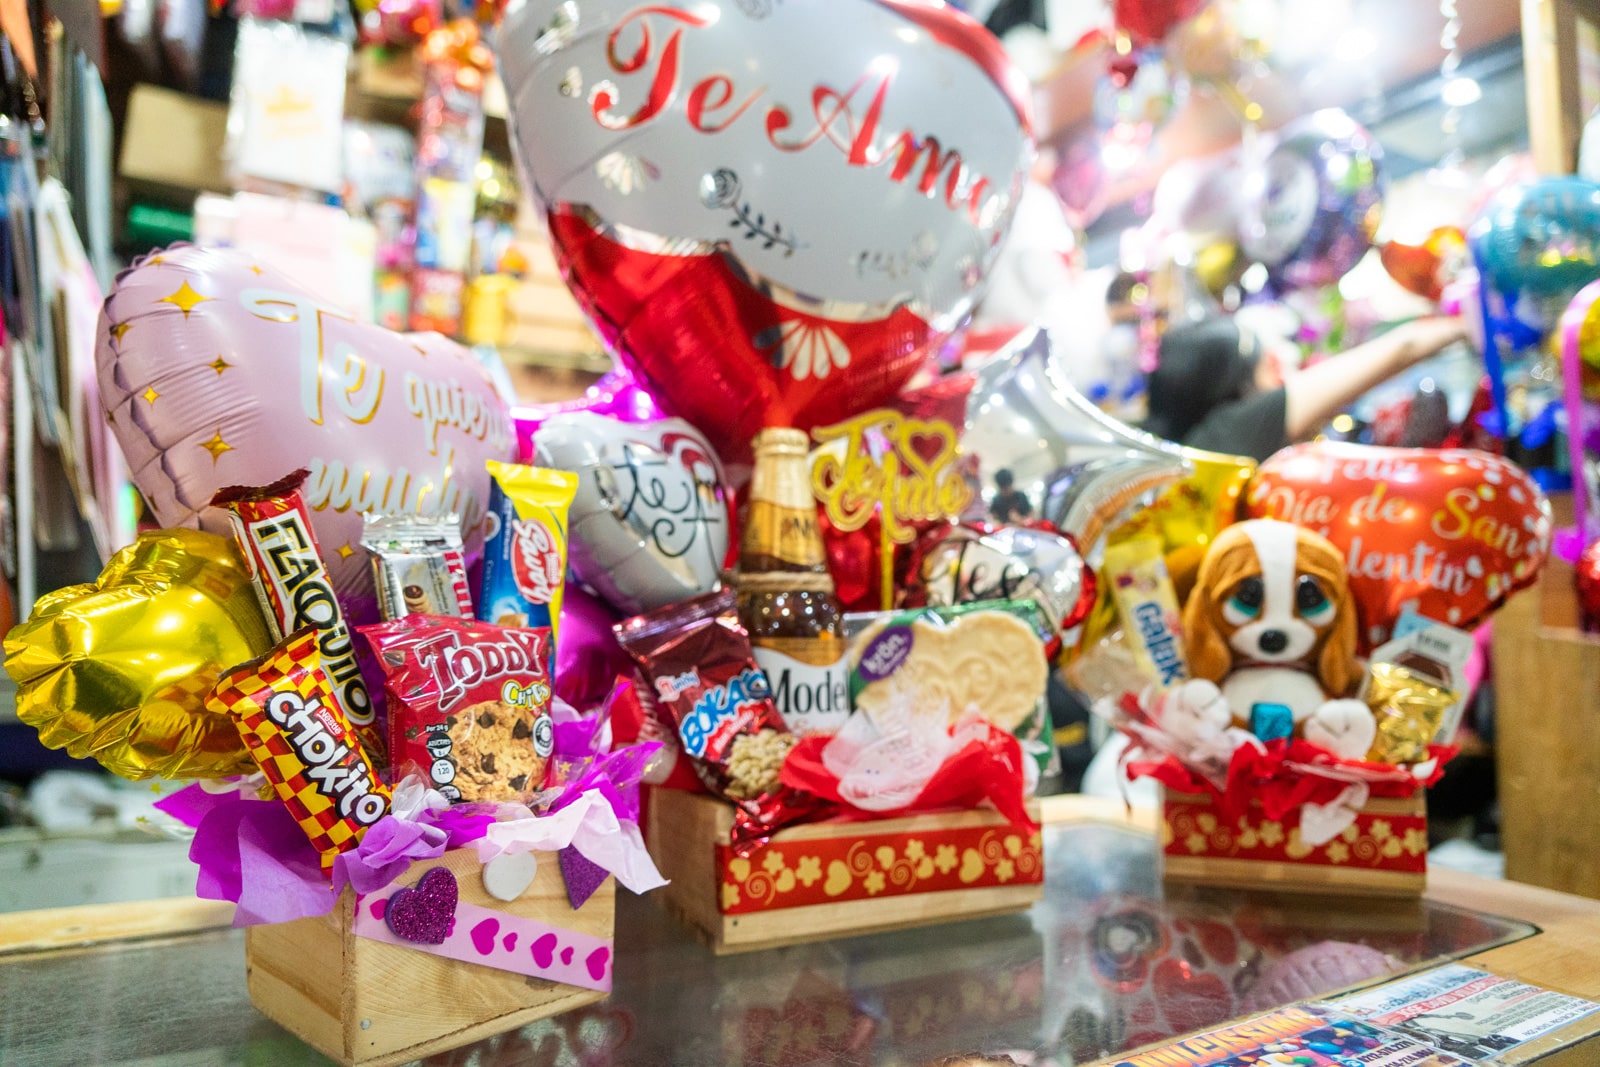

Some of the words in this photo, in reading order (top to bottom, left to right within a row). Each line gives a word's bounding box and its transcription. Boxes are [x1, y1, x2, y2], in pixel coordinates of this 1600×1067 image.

[591, 5, 768, 134] Te
[240, 288, 386, 425] Te
[513, 519, 557, 603] Savoy
[1349, 481, 1408, 524] de
[1431, 488, 1521, 558] San
[1347, 536, 1473, 596] lentín
[254, 515, 374, 722] FLAQUITO
[1135, 602, 1187, 686] Galak
[414, 629, 545, 712] TODDY
[762, 667, 850, 714] Model
